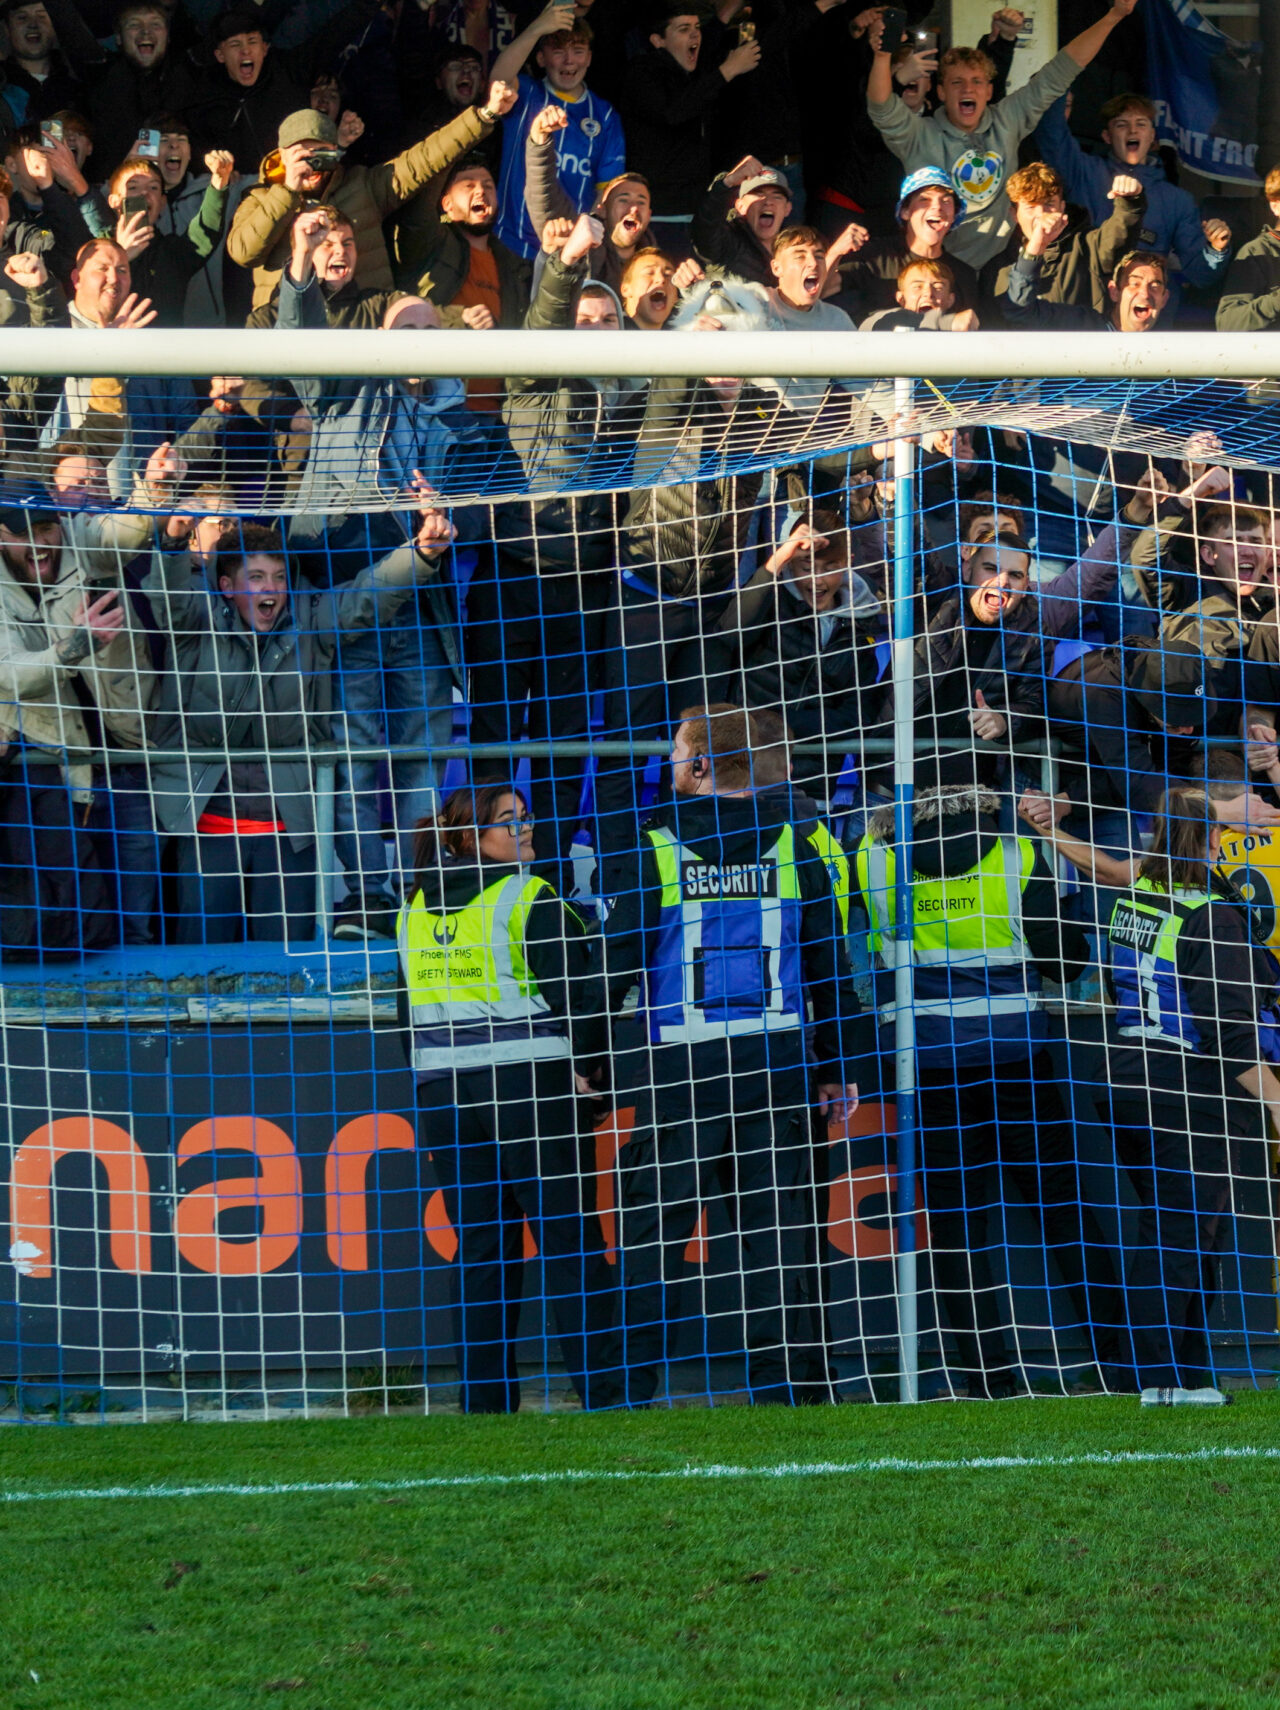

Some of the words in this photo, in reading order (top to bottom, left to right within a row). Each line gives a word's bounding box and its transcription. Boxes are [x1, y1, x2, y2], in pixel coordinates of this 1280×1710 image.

[685, 864, 771, 896] SECURITY
[917, 897, 976, 912] SECURITY
[1112, 910, 1158, 948] SECURITY
[455, 949, 472, 959] FMS
